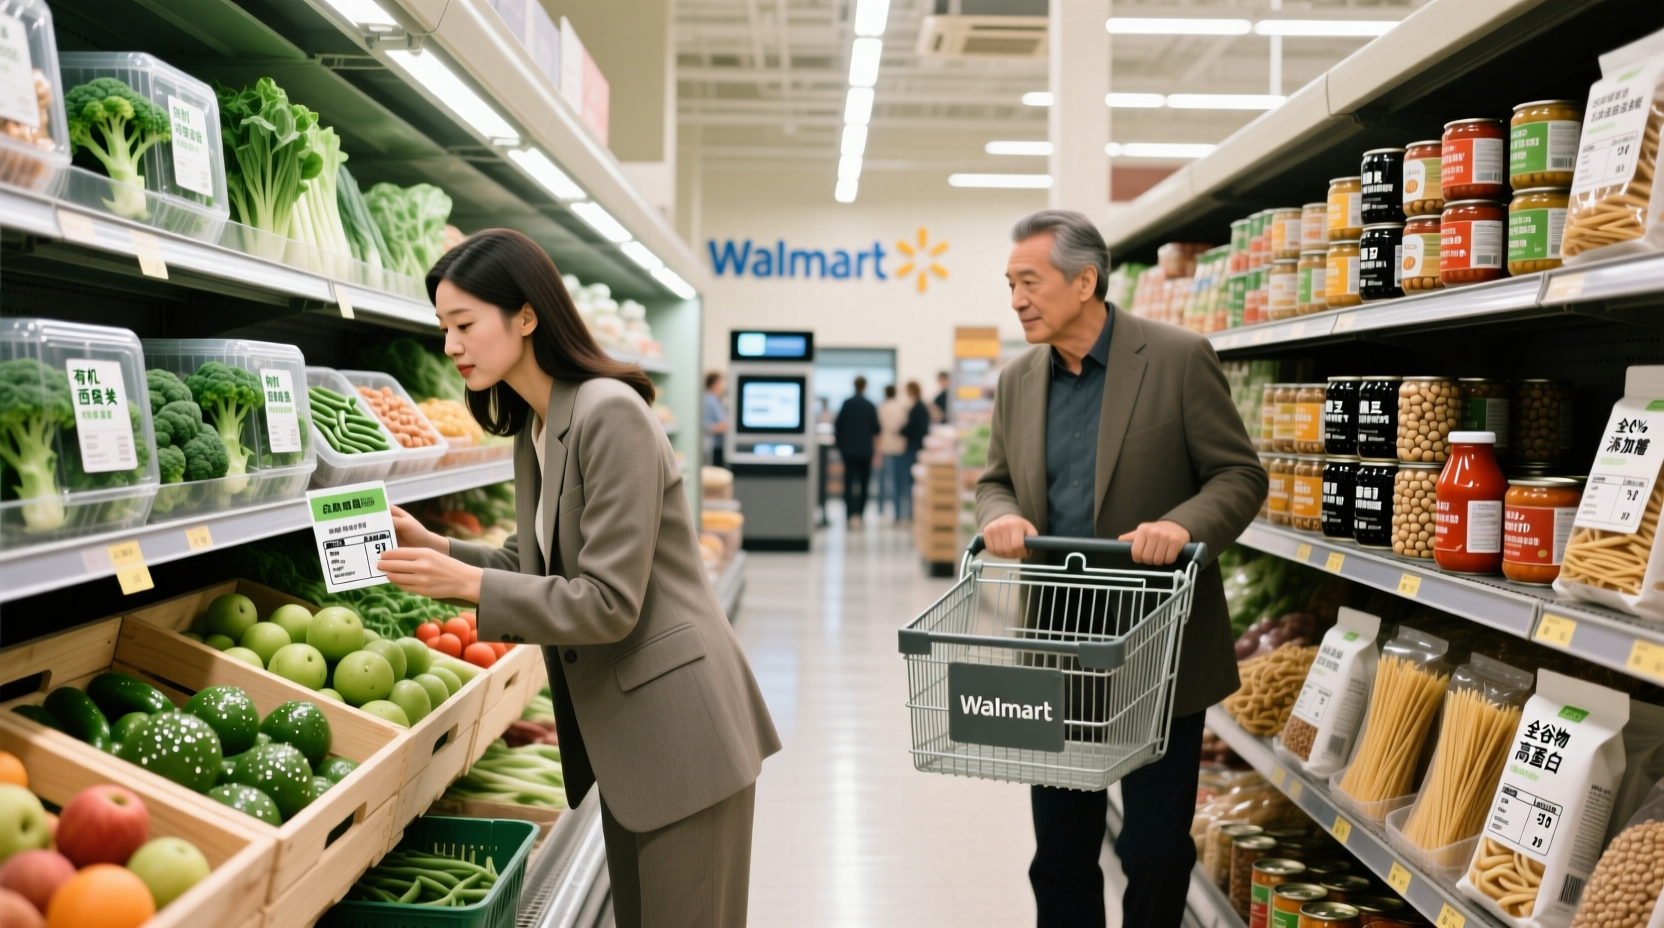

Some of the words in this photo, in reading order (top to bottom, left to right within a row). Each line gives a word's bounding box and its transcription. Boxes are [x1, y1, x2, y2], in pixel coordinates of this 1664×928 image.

[708, 240, 887, 279] Walmart
[960, 694, 1053, 722] Walmart
[1524, 719, 1571, 749] 全谷物
[1515, 741, 1563, 774] 高蛋白
